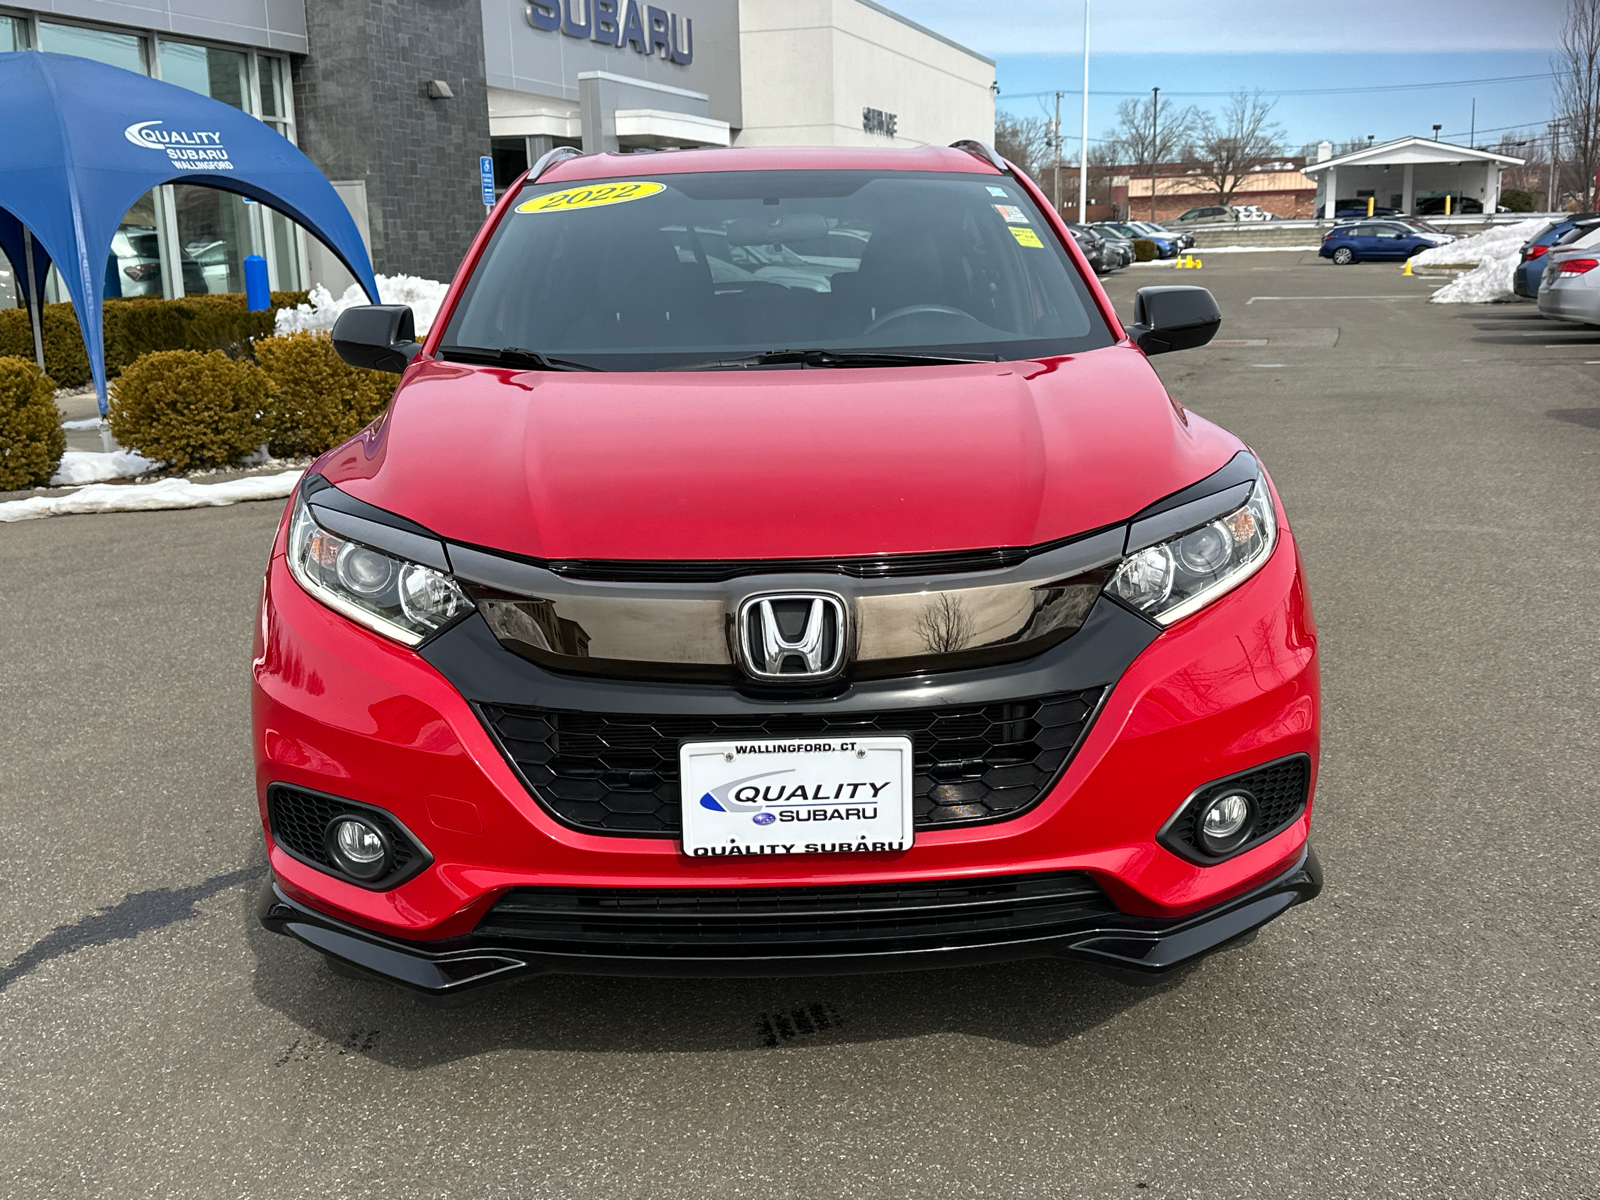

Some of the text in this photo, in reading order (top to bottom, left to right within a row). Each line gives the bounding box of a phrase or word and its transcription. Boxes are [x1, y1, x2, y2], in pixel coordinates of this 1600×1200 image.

[141, 129, 220, 144] QUALITY
[166, 149, 228, 160] SUBARU
[171, 160, 234, 170] WALLINGFORD
[539, 184, 641, 210] 2022
[735, 742, 857, 754] WALLINGFORD, CT
[734, 781, 891, 803] QUALITY
[779, 807, 878, 822] SUBARU
[693, 841, 904, 857] QUALITY SUBARU
